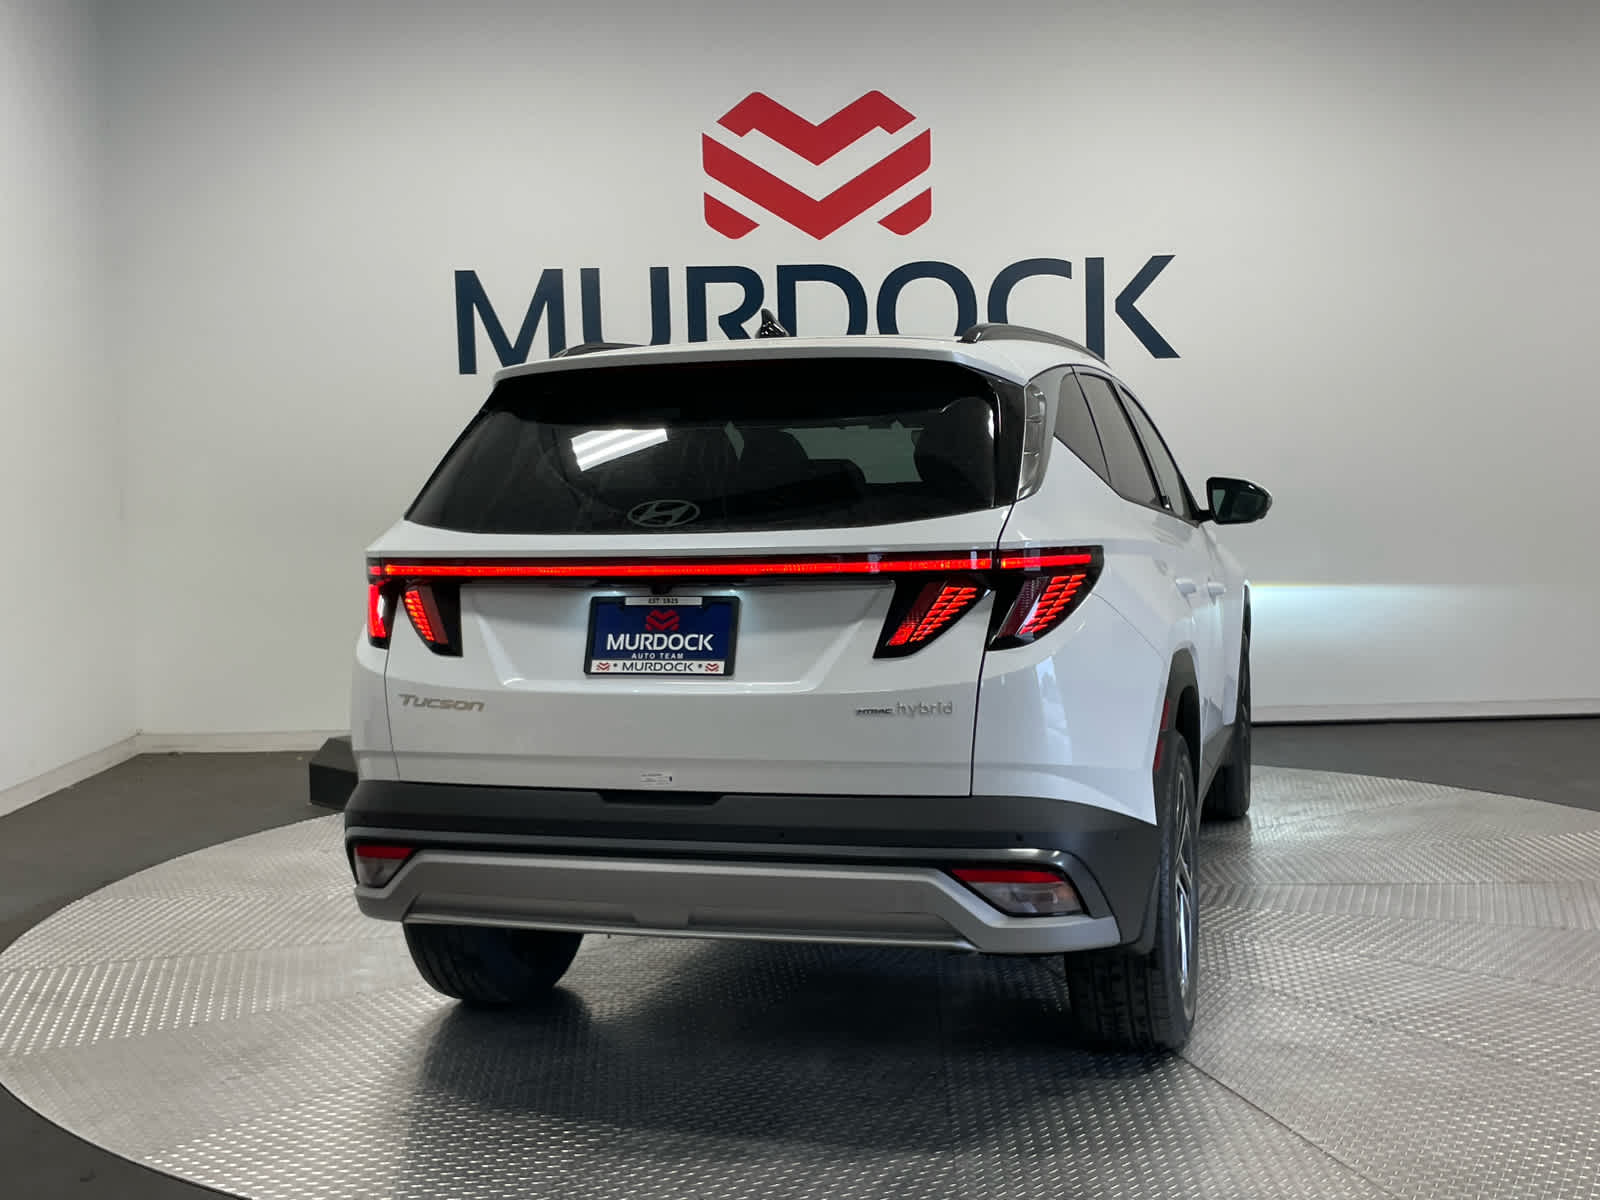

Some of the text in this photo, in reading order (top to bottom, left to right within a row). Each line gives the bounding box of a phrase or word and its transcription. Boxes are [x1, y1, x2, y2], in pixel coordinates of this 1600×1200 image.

[454, 254, 1181, 375] MURDOCK
[606, 633, 714, 651] MURDOCK
[631, 652, 684, 660] AUTO TEAM
[621, 661, 694, 672] MURDOCK
[896, 700, 953, 718] hybrid
